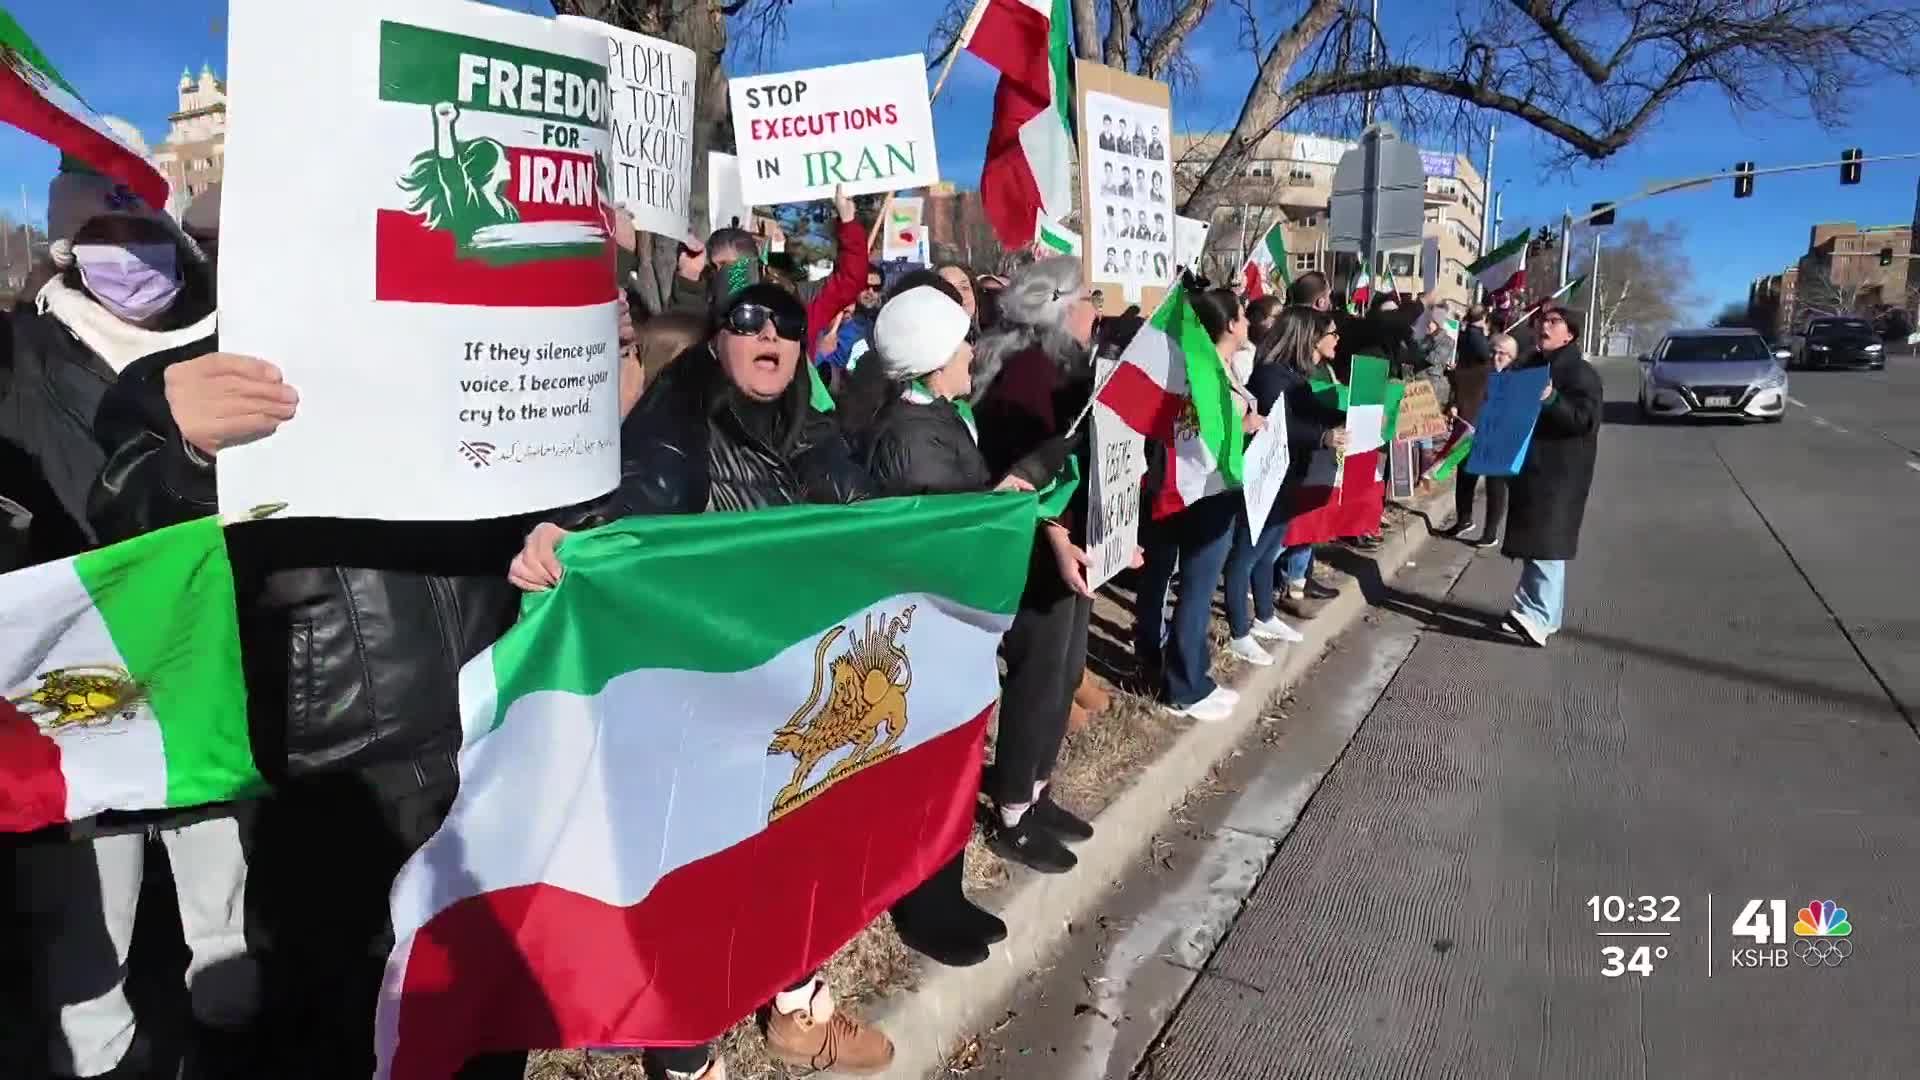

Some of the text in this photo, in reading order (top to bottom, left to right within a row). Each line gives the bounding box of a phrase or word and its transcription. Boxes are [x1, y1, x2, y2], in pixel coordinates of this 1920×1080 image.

[626, 85, 684, 134] TOTAL
[746, 80, 808, 109] STOP
[543, 123, 579, 149] FOR
[751, 104, 897, 140] EXECUTIONS
[611, 118, 689, 172] ACKOUT
[518, 153, 594, 207] IRAN
[757, 141, 918, 187] IN IRAN
[620, 162, 676, 212] THEIR
[464, 341, 607, 366] If they silence your
[460, 370, 609, 393] voice. I become your
[459, 396, 592, 427] cry to the world.
